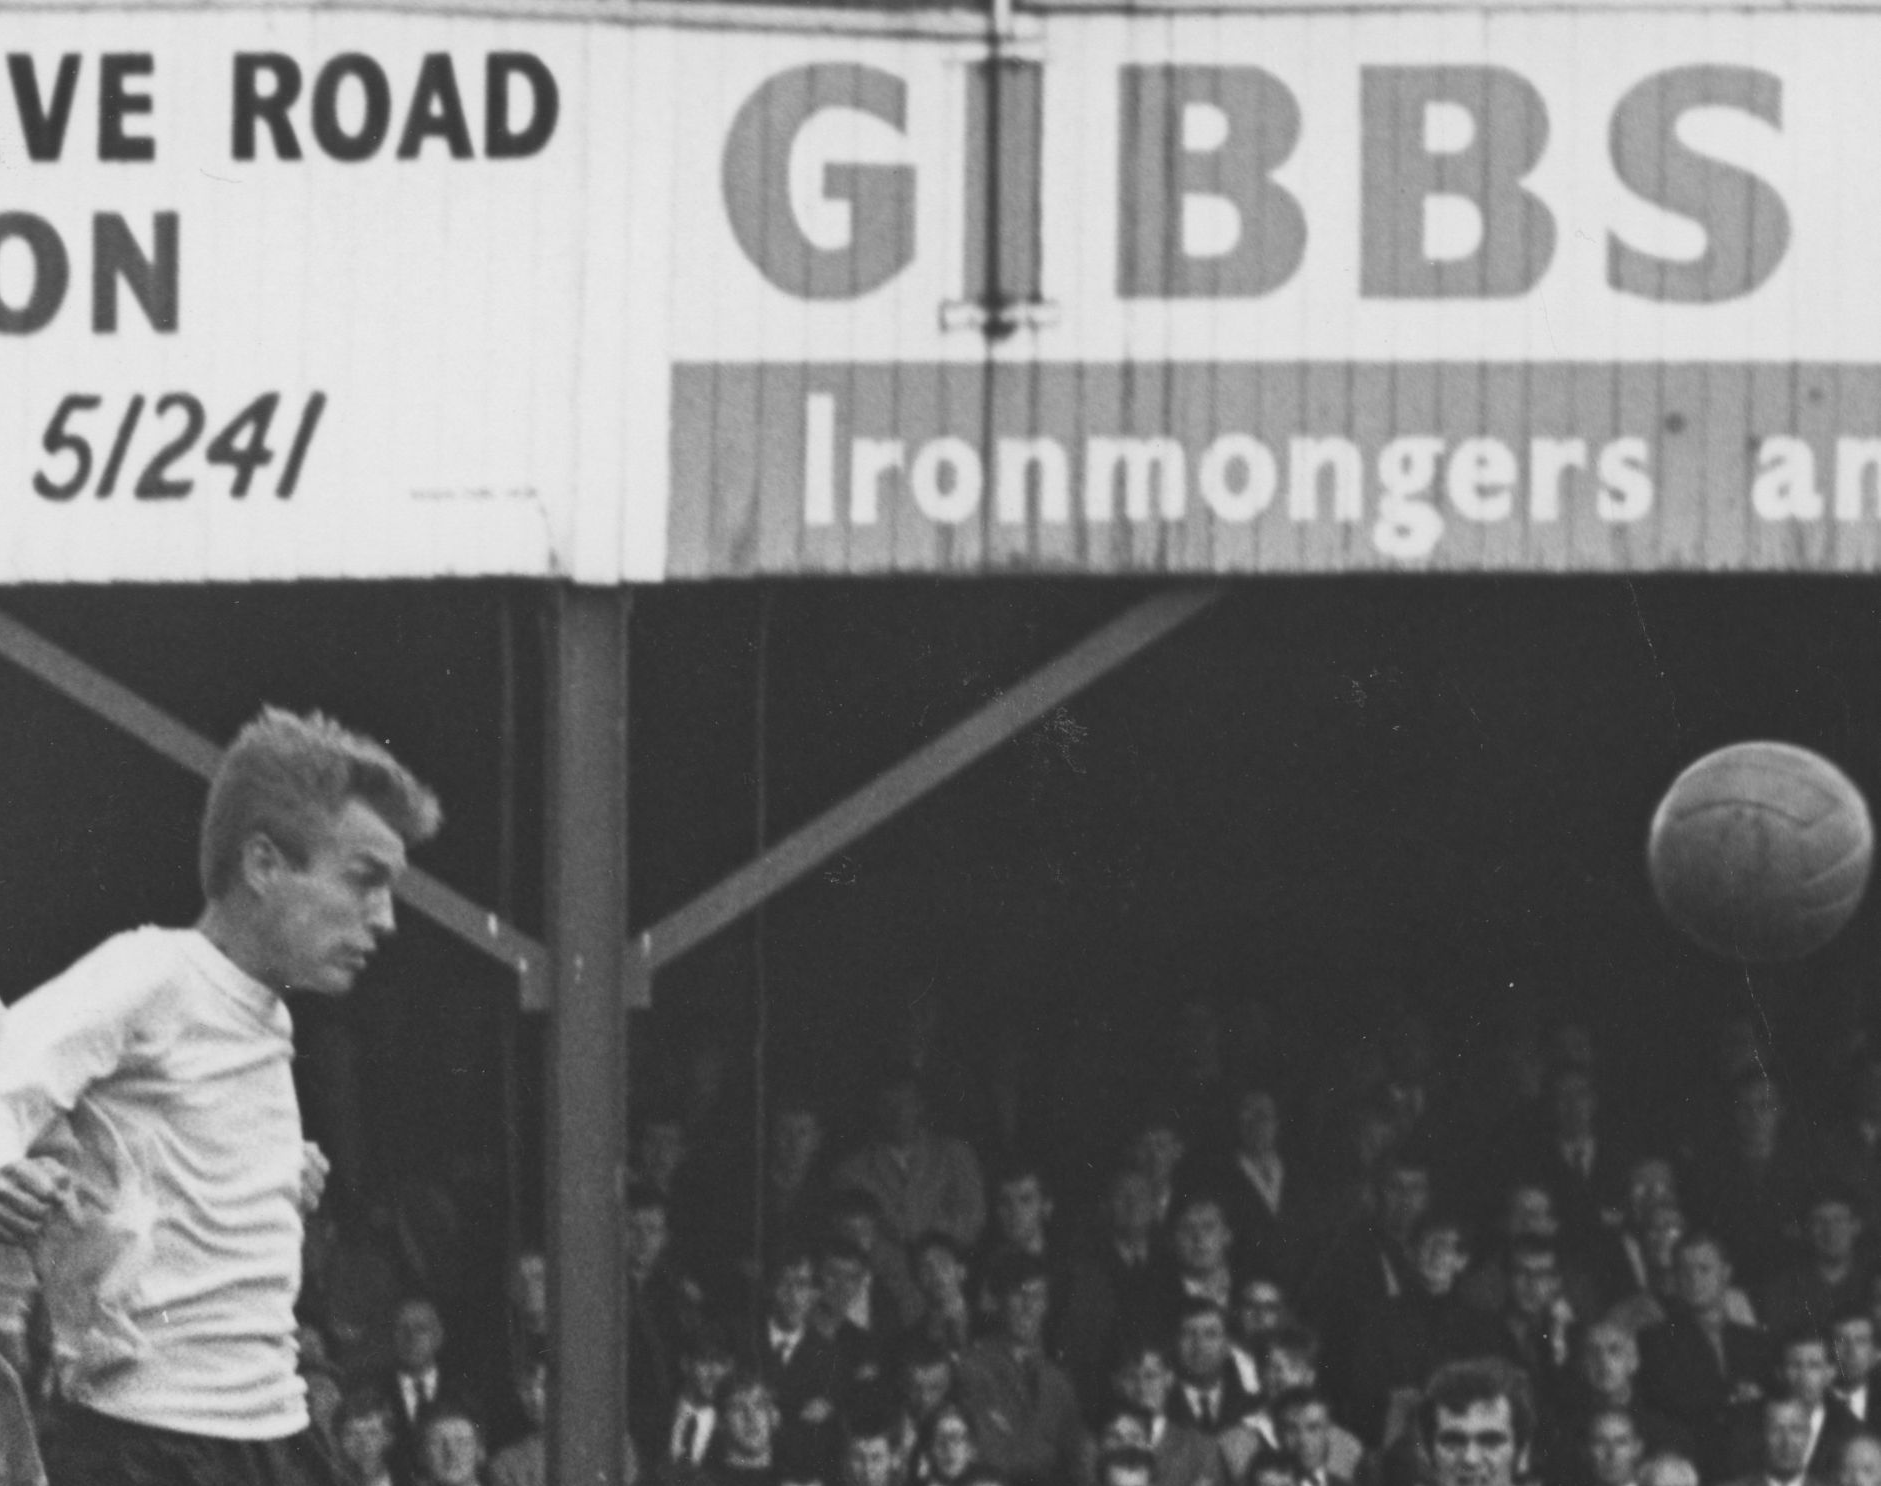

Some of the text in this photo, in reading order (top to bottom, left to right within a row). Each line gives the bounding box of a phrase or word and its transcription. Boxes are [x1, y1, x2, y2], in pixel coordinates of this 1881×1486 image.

[231, 51, 561, 163] ROAD
[720, 61, 1793, 304] GIBBS
[30, 390, 328, 503] 51241
[805, 392, 1654, 560] Ironmongers
